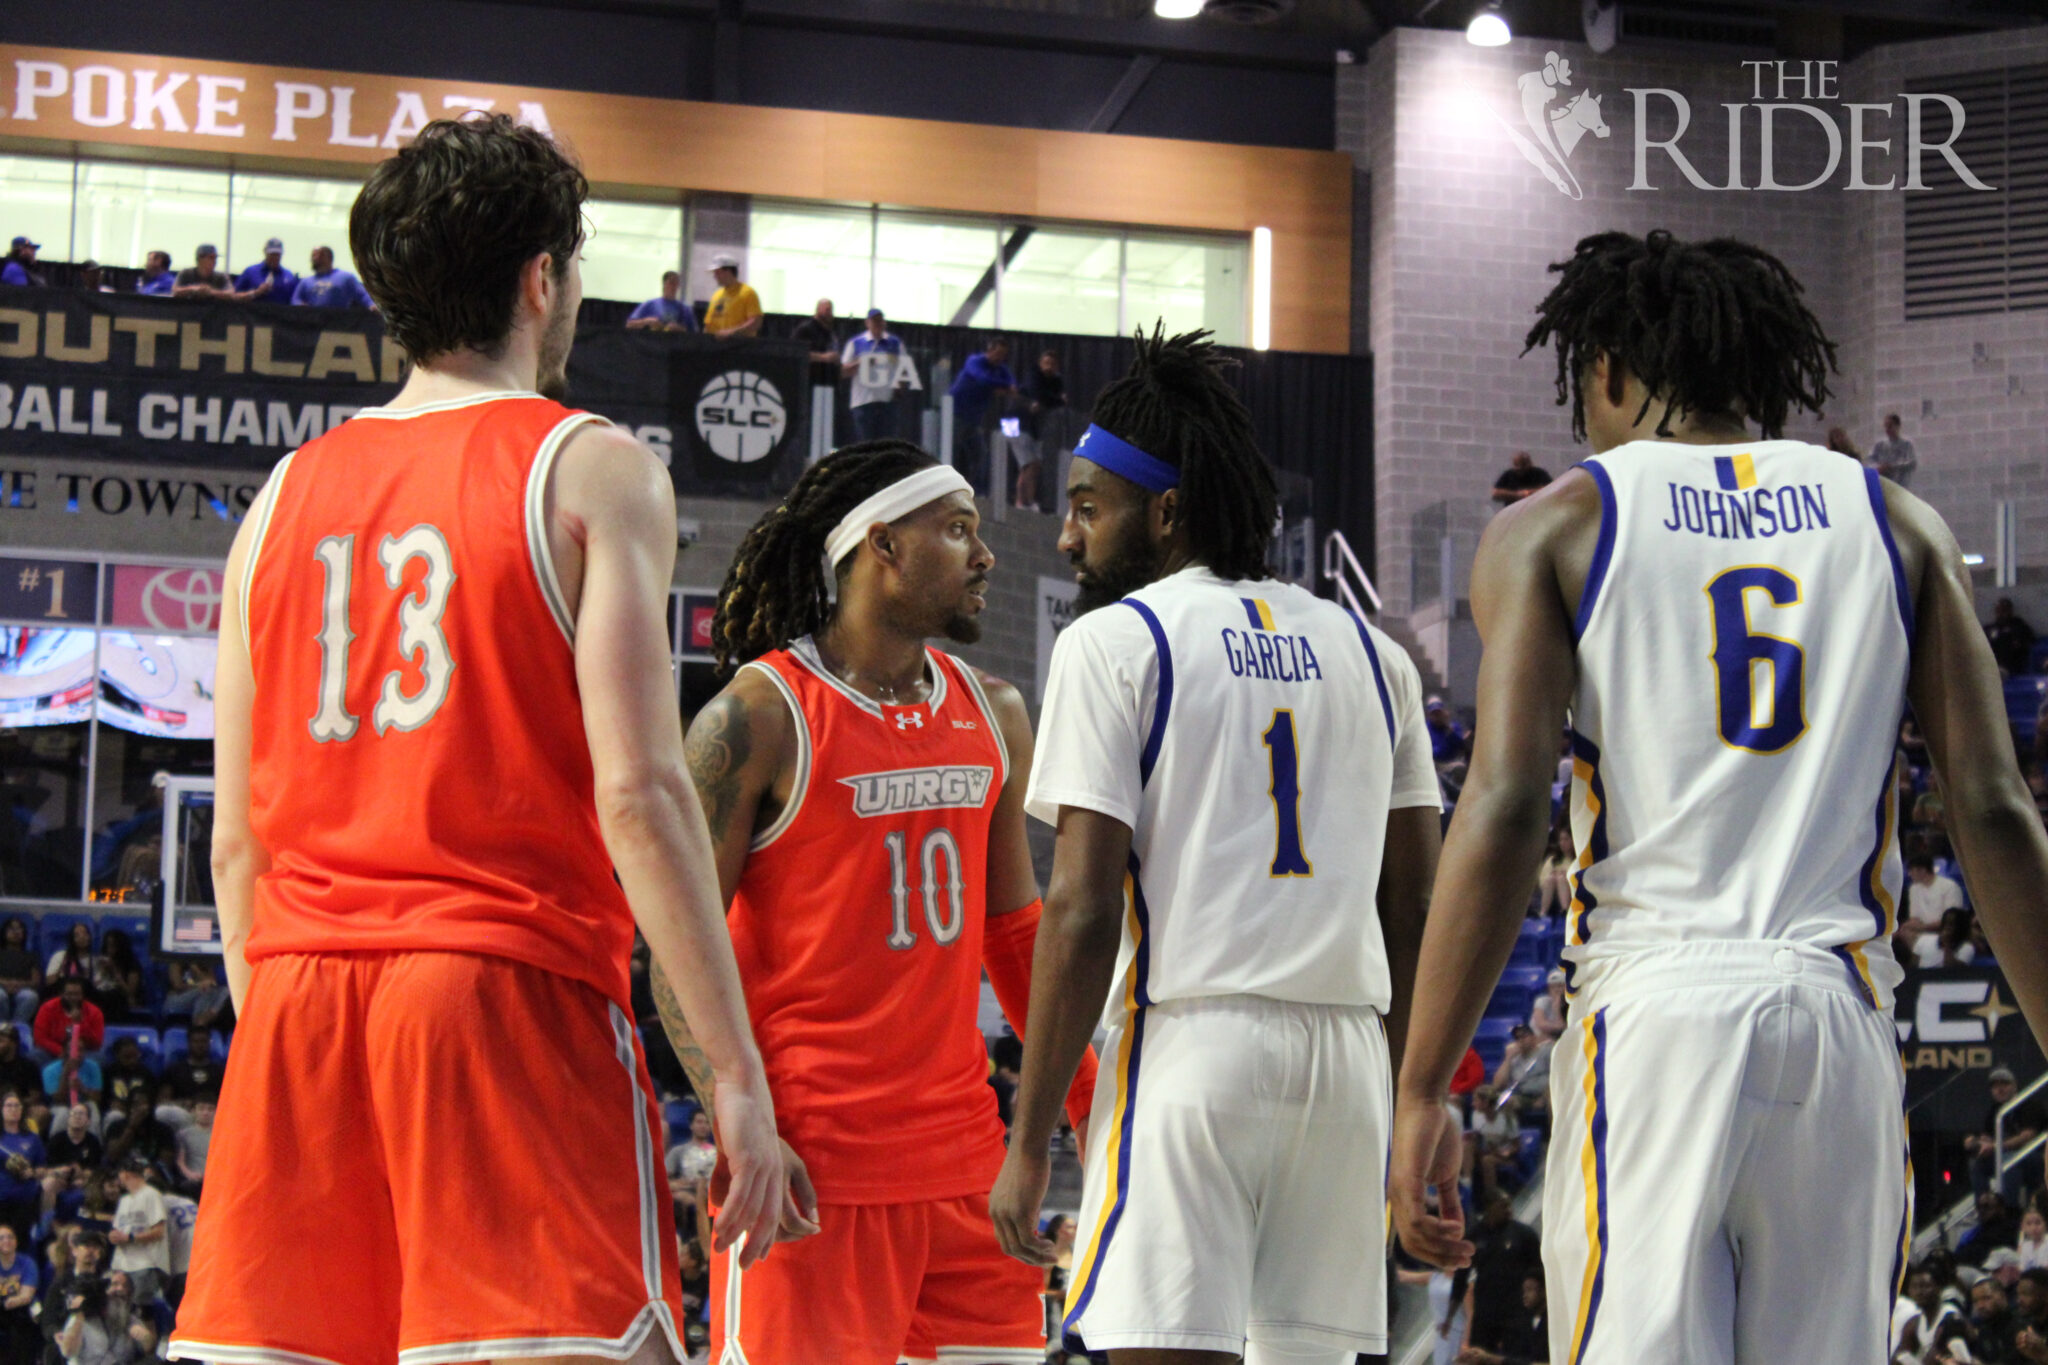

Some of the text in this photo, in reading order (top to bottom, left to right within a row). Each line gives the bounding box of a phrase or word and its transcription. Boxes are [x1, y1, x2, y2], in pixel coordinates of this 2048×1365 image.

[12, 59, 246, 138] POKE
[859, 353, 923, 391] GA
[702, 407, 772, 428] SLC
[1663, 482, 1831, 540] JOHNSON
[18, 567, 68, 618] #1
[308, 523, 458, 743] 13
[1221, 627, 1323, 683] GARCIA
[1702, 564, 1811, 756] 6
[850, 765, 994, 818] UTRGV
[1261, 707, 1313, 879] 1
[883, 827, 966, 951] 10
